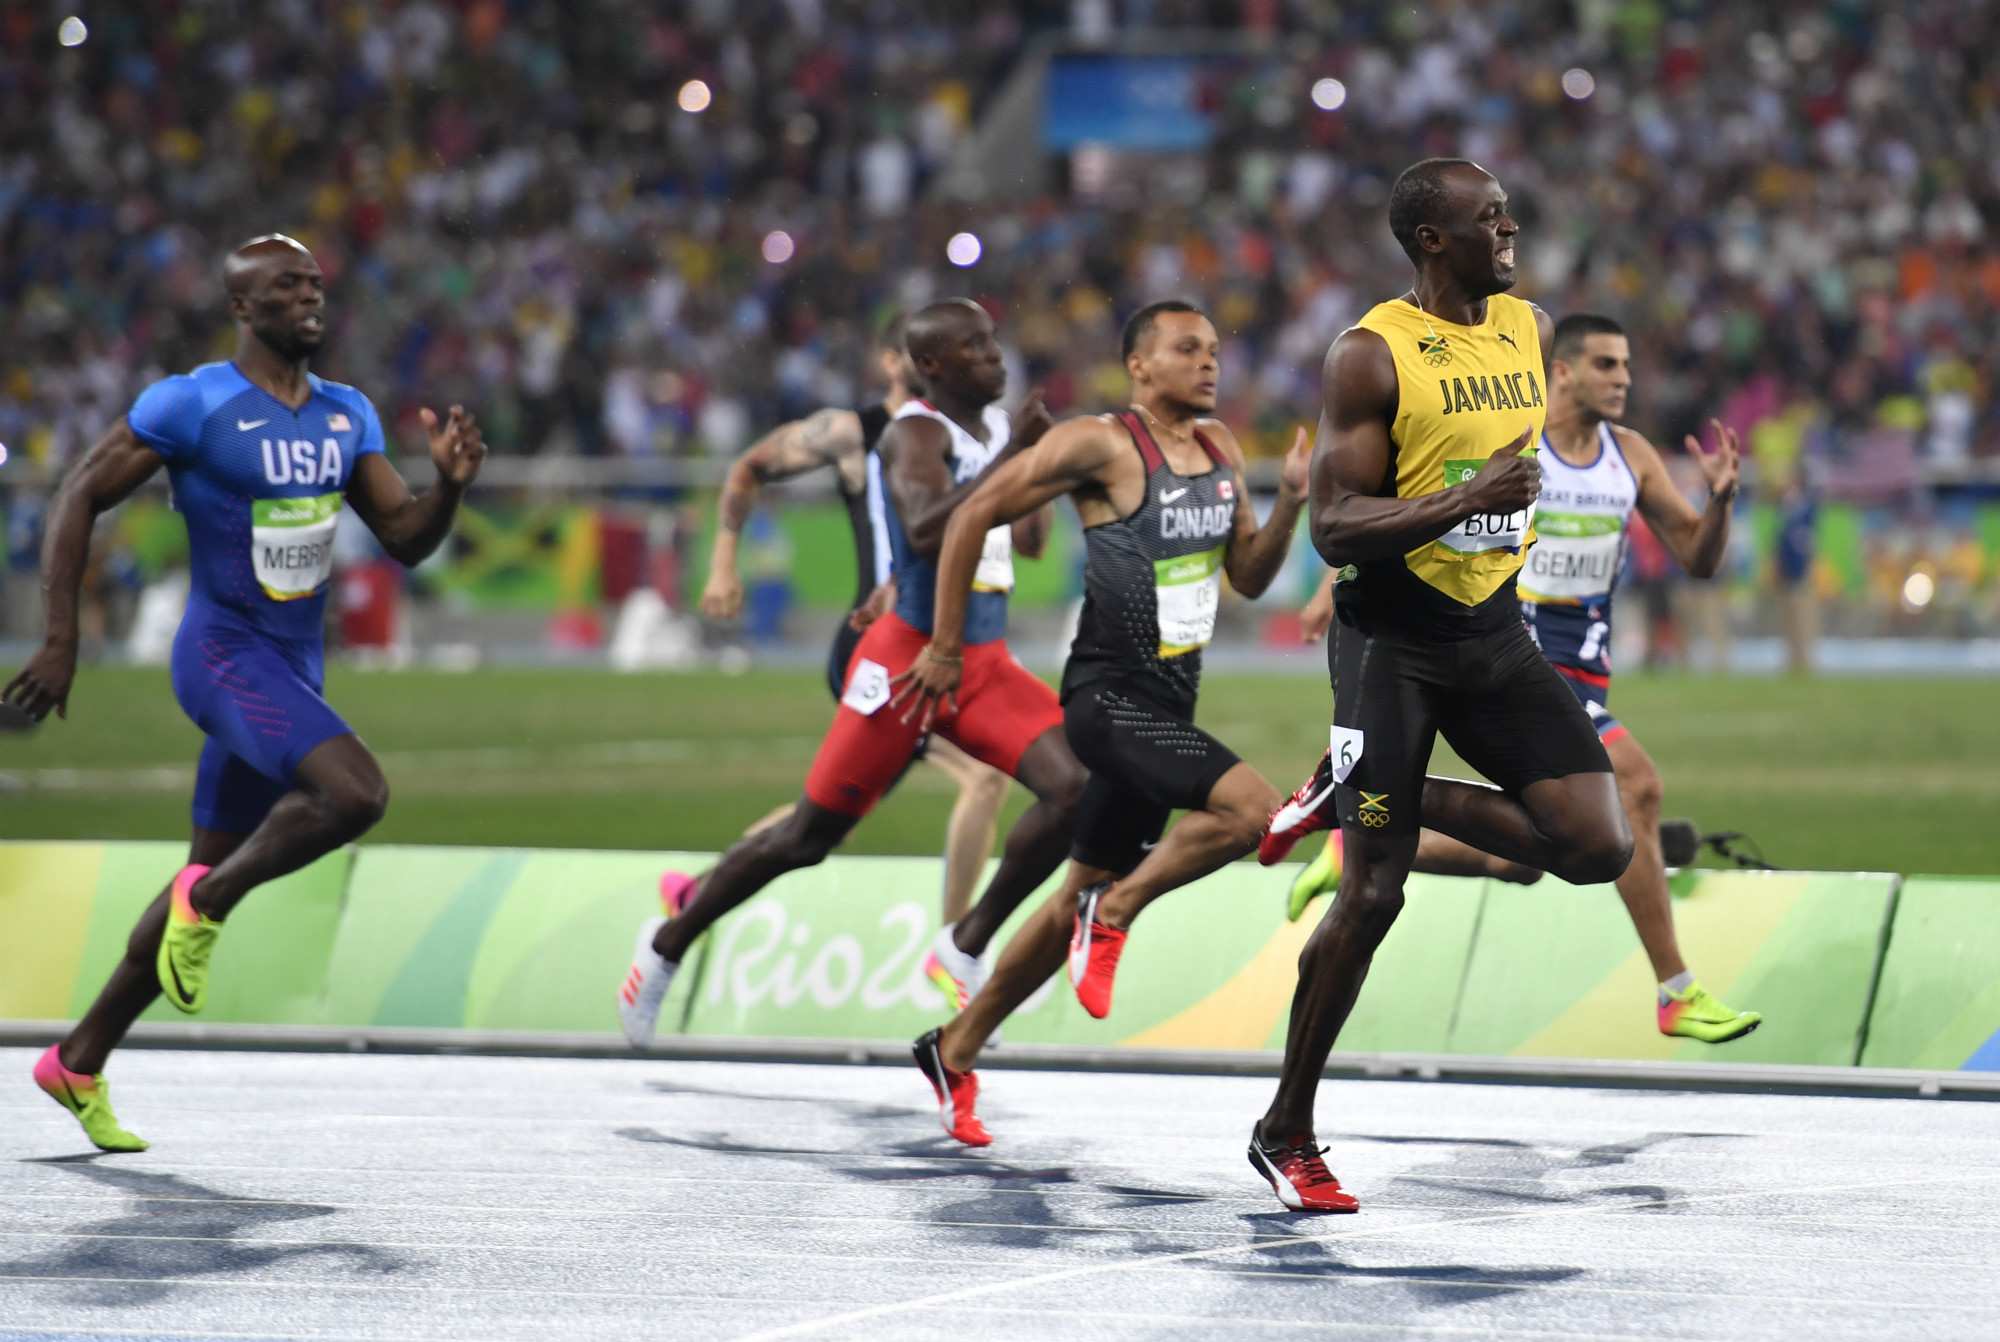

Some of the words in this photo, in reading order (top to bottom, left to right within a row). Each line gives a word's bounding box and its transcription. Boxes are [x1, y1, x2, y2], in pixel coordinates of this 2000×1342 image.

[1439, 371, 1544, 415] JAMAICA
[261, 438, 343, 487] USA
[863, 674, 883, 700] 3
[1340, 739, 1353, 767] 6
